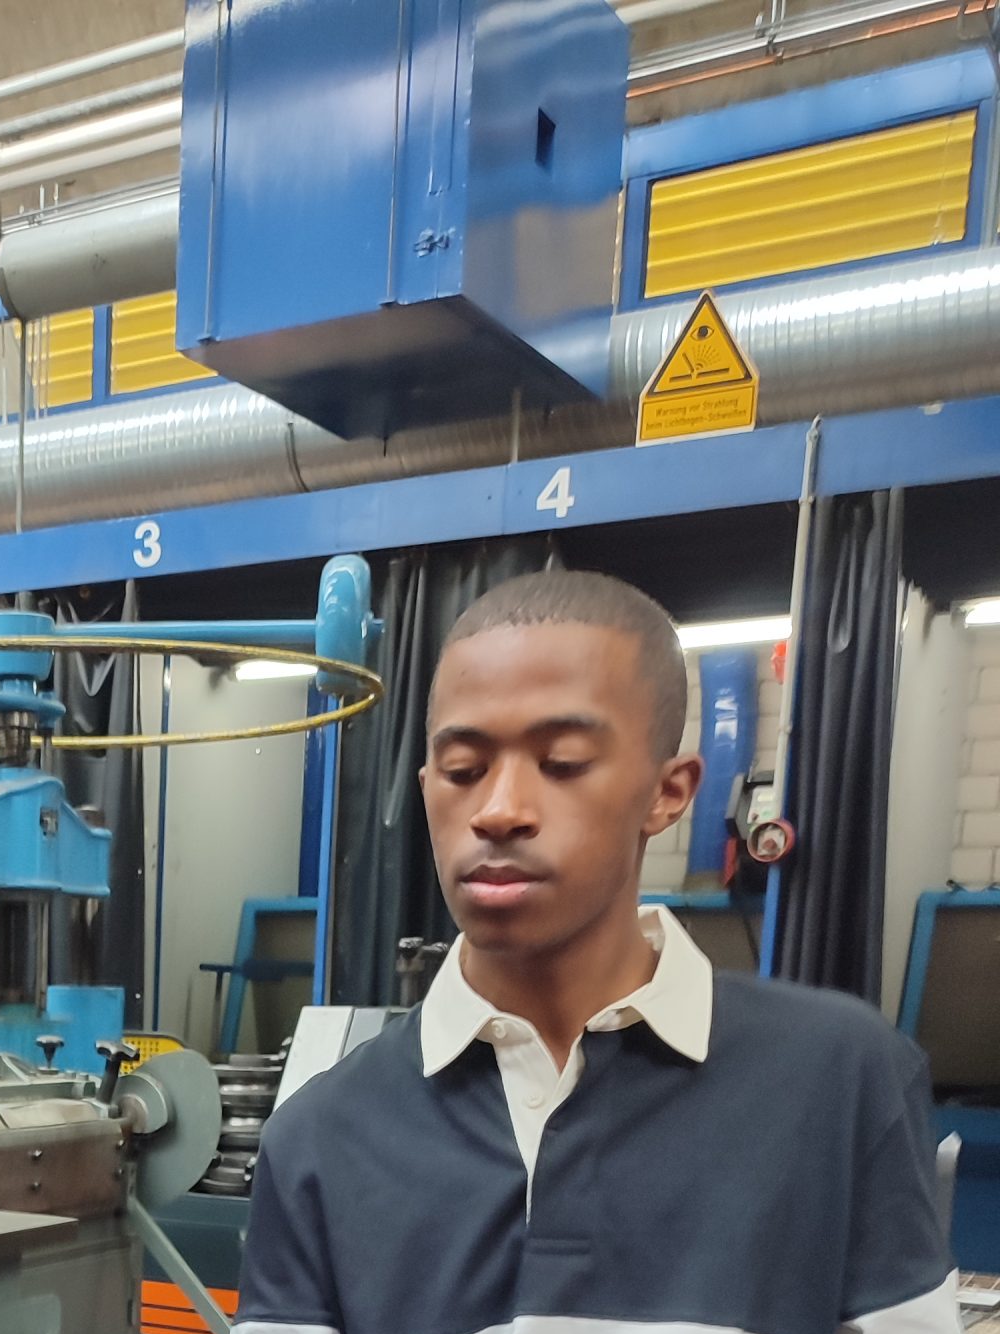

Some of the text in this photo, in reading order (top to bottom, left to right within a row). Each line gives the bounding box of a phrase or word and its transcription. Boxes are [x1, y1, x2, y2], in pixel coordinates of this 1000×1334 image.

[655, 398, 739, 417] Warnung vor Strahlung
[536, 467, 575, 518] 4
[133, 520, 162, 568] 3
